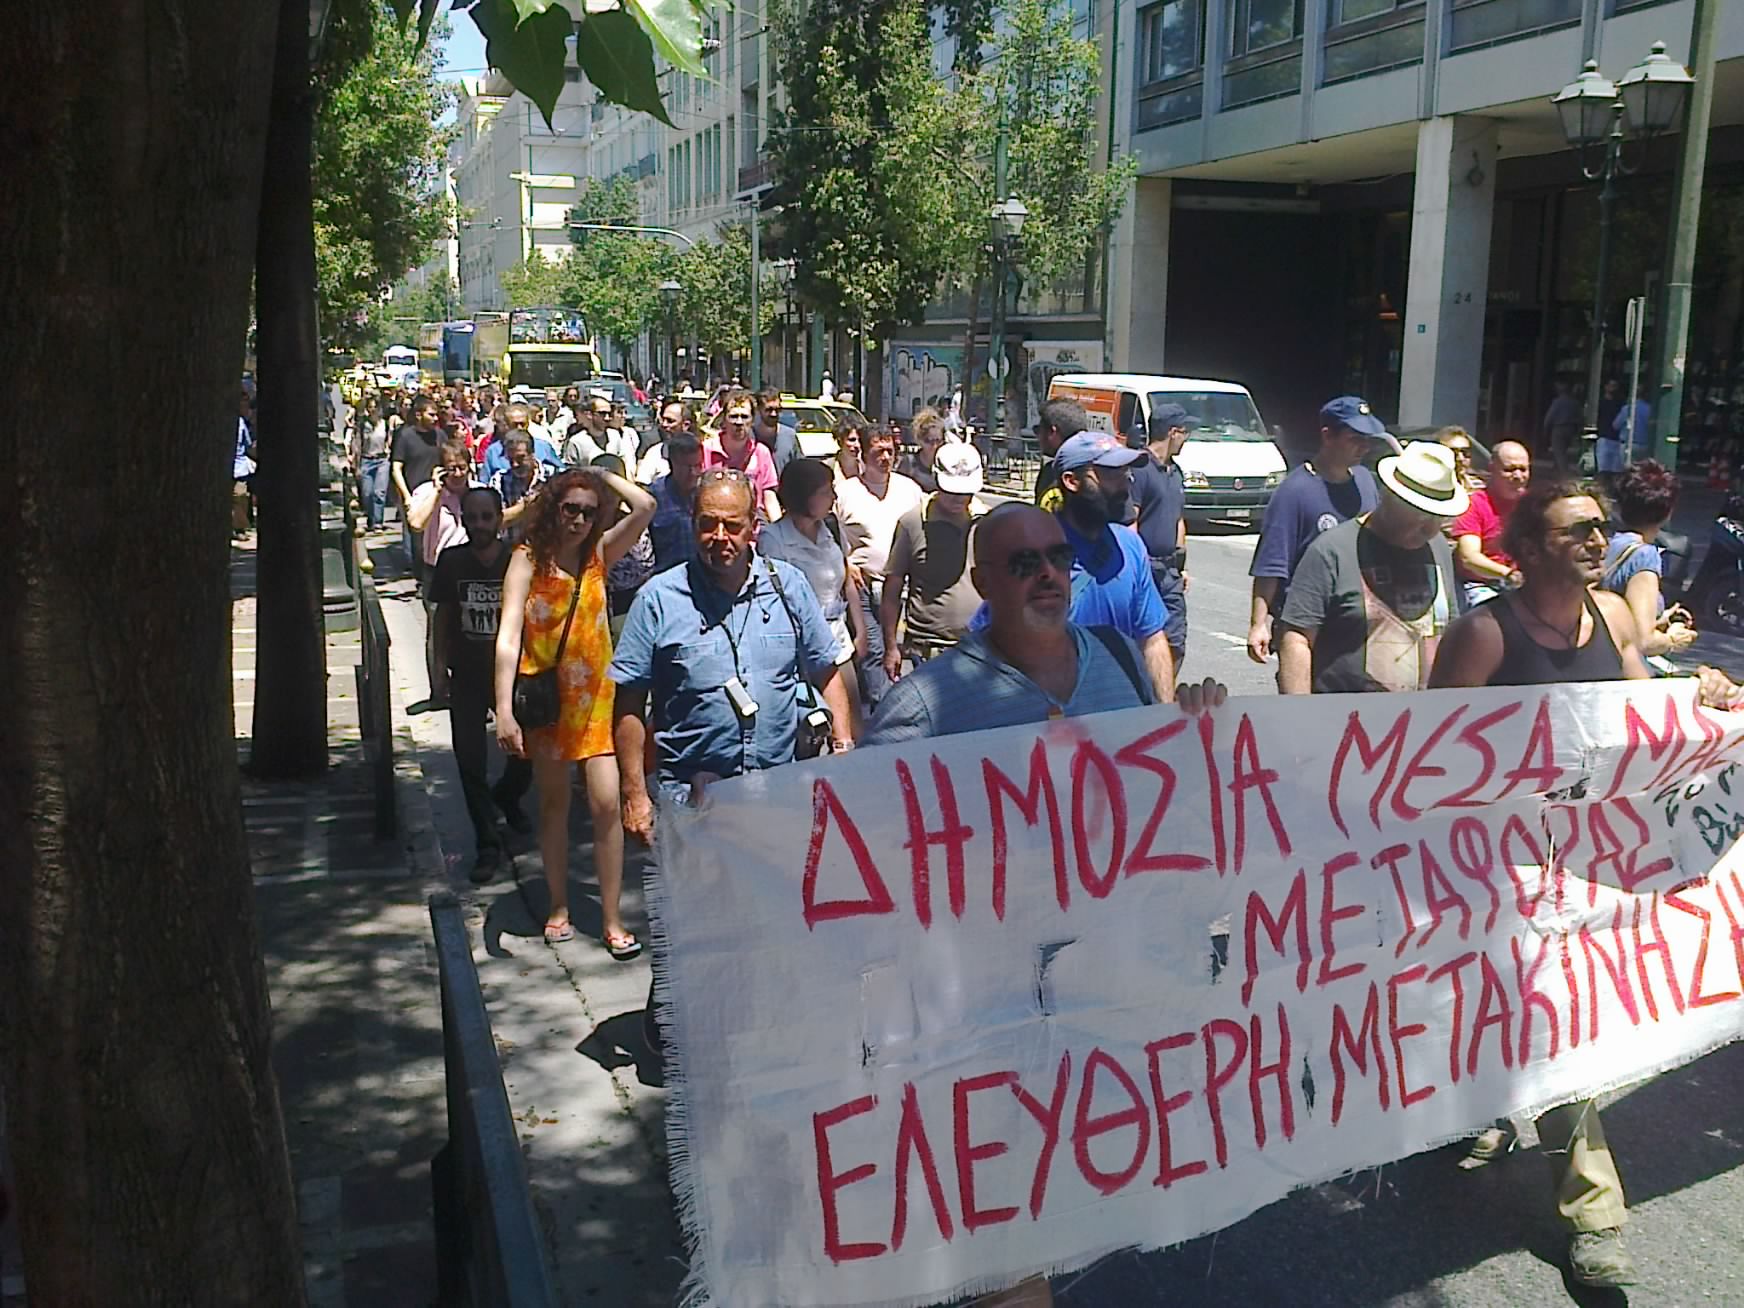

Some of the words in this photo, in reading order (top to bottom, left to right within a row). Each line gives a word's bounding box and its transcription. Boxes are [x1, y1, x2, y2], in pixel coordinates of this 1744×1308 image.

[802, 709, 1292, 931] ΔΗΜΟΣΙΑ
[1328, 694, 1564, 839] ΜΕΣΑ
[1241, 797, 1674, 1007] ΜΕΤΑΦΟΡΑΣ
[813, 1001, 1295, 1266] ΕΛΕΥΘΕΡΗ
